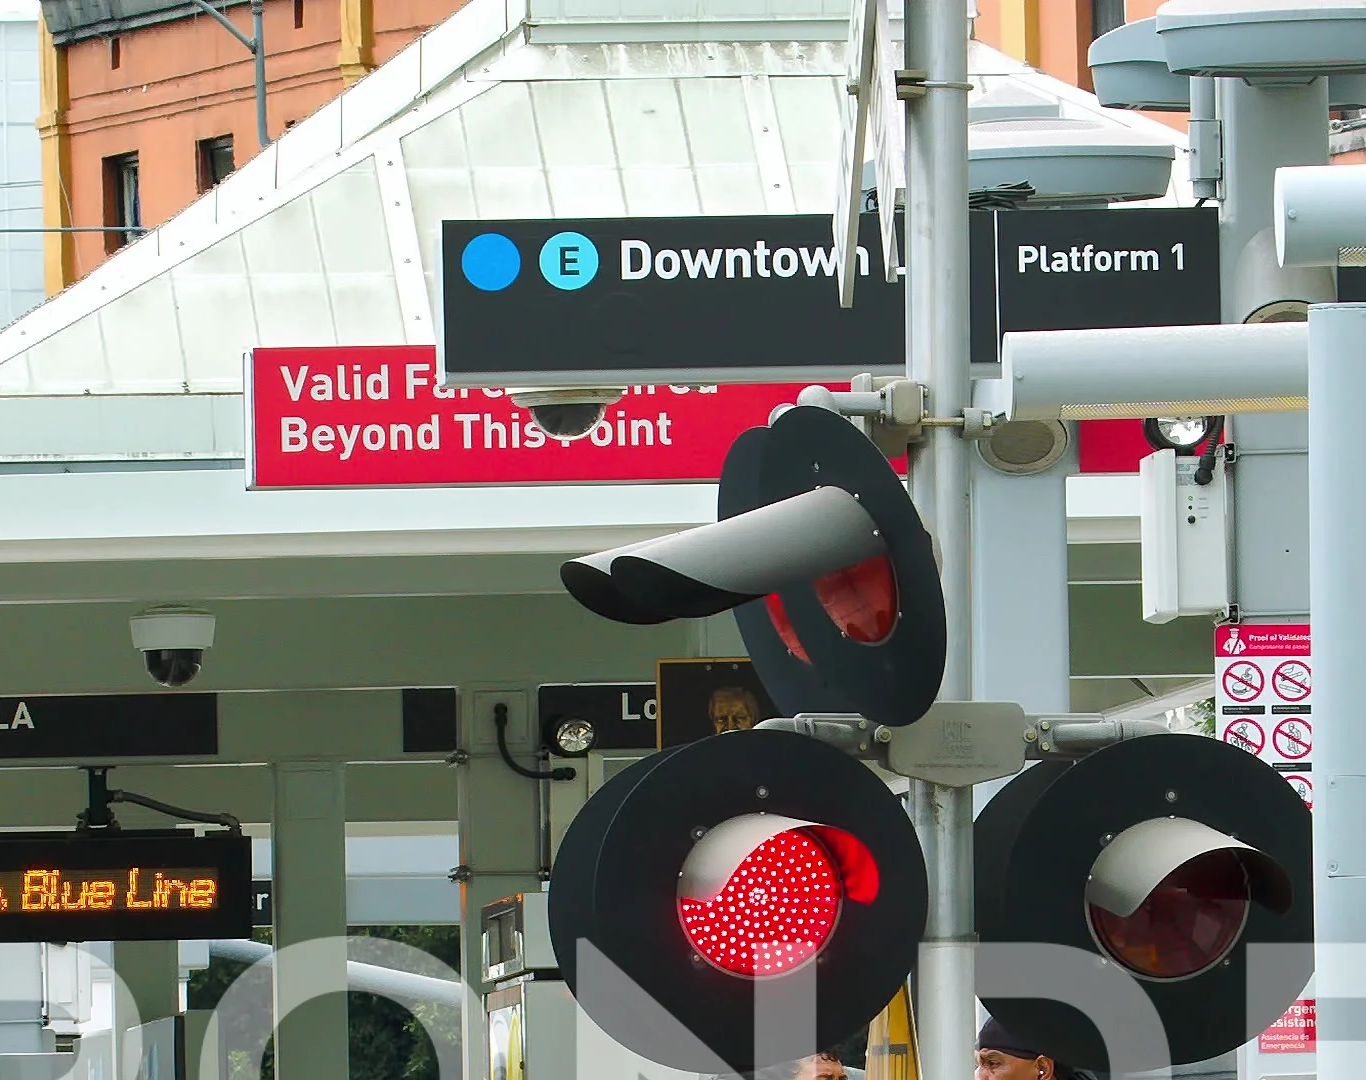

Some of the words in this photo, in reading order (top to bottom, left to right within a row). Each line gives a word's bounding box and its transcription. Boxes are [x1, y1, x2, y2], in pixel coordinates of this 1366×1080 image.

[559, 246, 580, 275] E
[620, 239, 870, 280] Downtown
[1018, 243, 1160, 273] Platform
[1171, 243, 1185, 271] 1
[279, 363, 389, 401] Valid
[280, 415, 439, 460] Beyond
[455, 411, 547, 448] This
[561, 410, 674, 448] oint
[622, 692, 656, 720] Lo
[21, 869, 115, 911] Blue
[127, 867, 216, 908] Line
